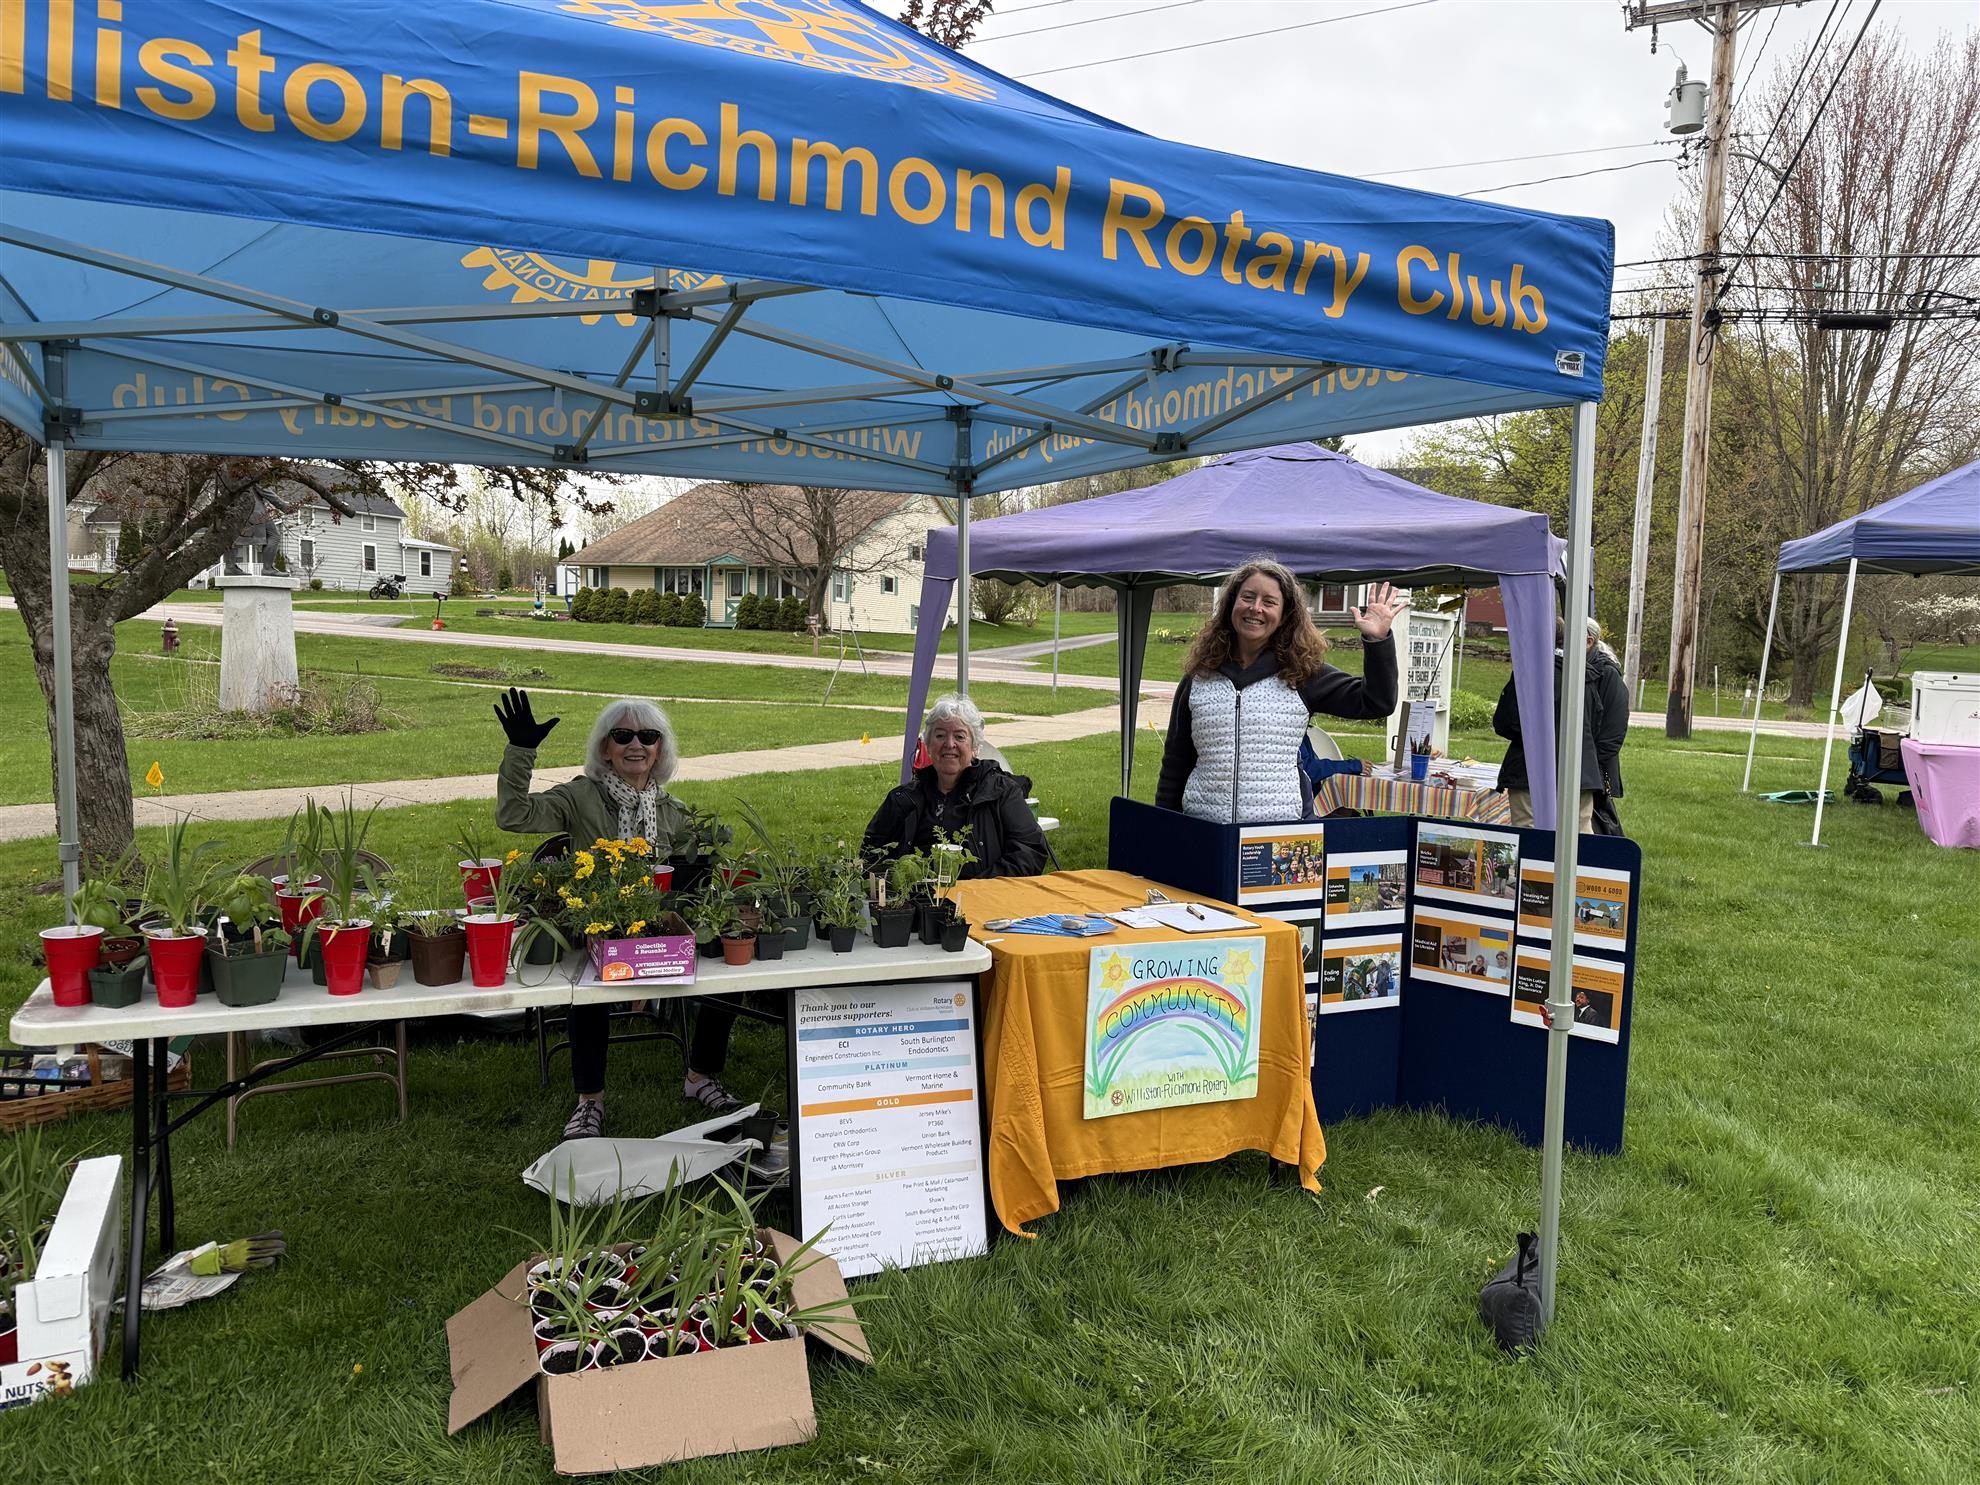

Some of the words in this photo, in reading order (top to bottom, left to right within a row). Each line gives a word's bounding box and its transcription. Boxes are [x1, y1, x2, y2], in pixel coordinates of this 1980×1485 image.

[1101, 177, 1370, 318] Rotary
[1397, 245, 1548, 334] Club
[1133, 956, 1218, 979] GROWING
[933, 997, 952, 1005] Rotary
[800, 1003, 829, 1012] Thank
[831, 1003, 847, 1011] you
[1106, 986, 1241, 1039] COMMUNITY
[800, 1014, 841, 1024] generous
[843, 1010, 893, 1022] supporters!
[856, 1026, 888, 1035] ROTARY
[922, 1035, 955, 1045] Burlington
[909, 1045, 948, 1055] Endodontics
[805, 1054, 834, 1062] Engineers
[835, 1051, 871, 1059] Construction
[865, 1062, 908, 1071] PLATINUM
[906, 1073, 932, 1081] Vermont
[1168, 1072, 1184, 1081] WITH
[818, 1081, 854, 1092] Community
[856, 1080, 871, 1088] Bank
[922, 1082, 943, 1090] Marine
[1124, 1080, 1201, 1104] Williston-Richmond
[1203, 1079, 1228, 1095] Rotary
[814, 1129, 842, 1139] Champlain
[844, 1126, 877, 1136] Orthodontics
[847, 1140, 860, 1148] Corp
[901, 1144, 924, 1152] Vermont
[925, 1141, 951, 1149] Wholesale
[812, 1153, 839, 1163] Evergreen
[840, 1151, 864, 1160] Physician
[865, 1148, 881, 1157] Group
[876, 1170, 906, 1180] SILVER
[852, 1199, 869, 1208] Storage
[919, 1206, 943, 1216] Burlington
[959, 1203, 969, 1211] Corp
[936, 1224, 961, 1232] Mechanical
[6, 1382, 44, 1400] NUTS
